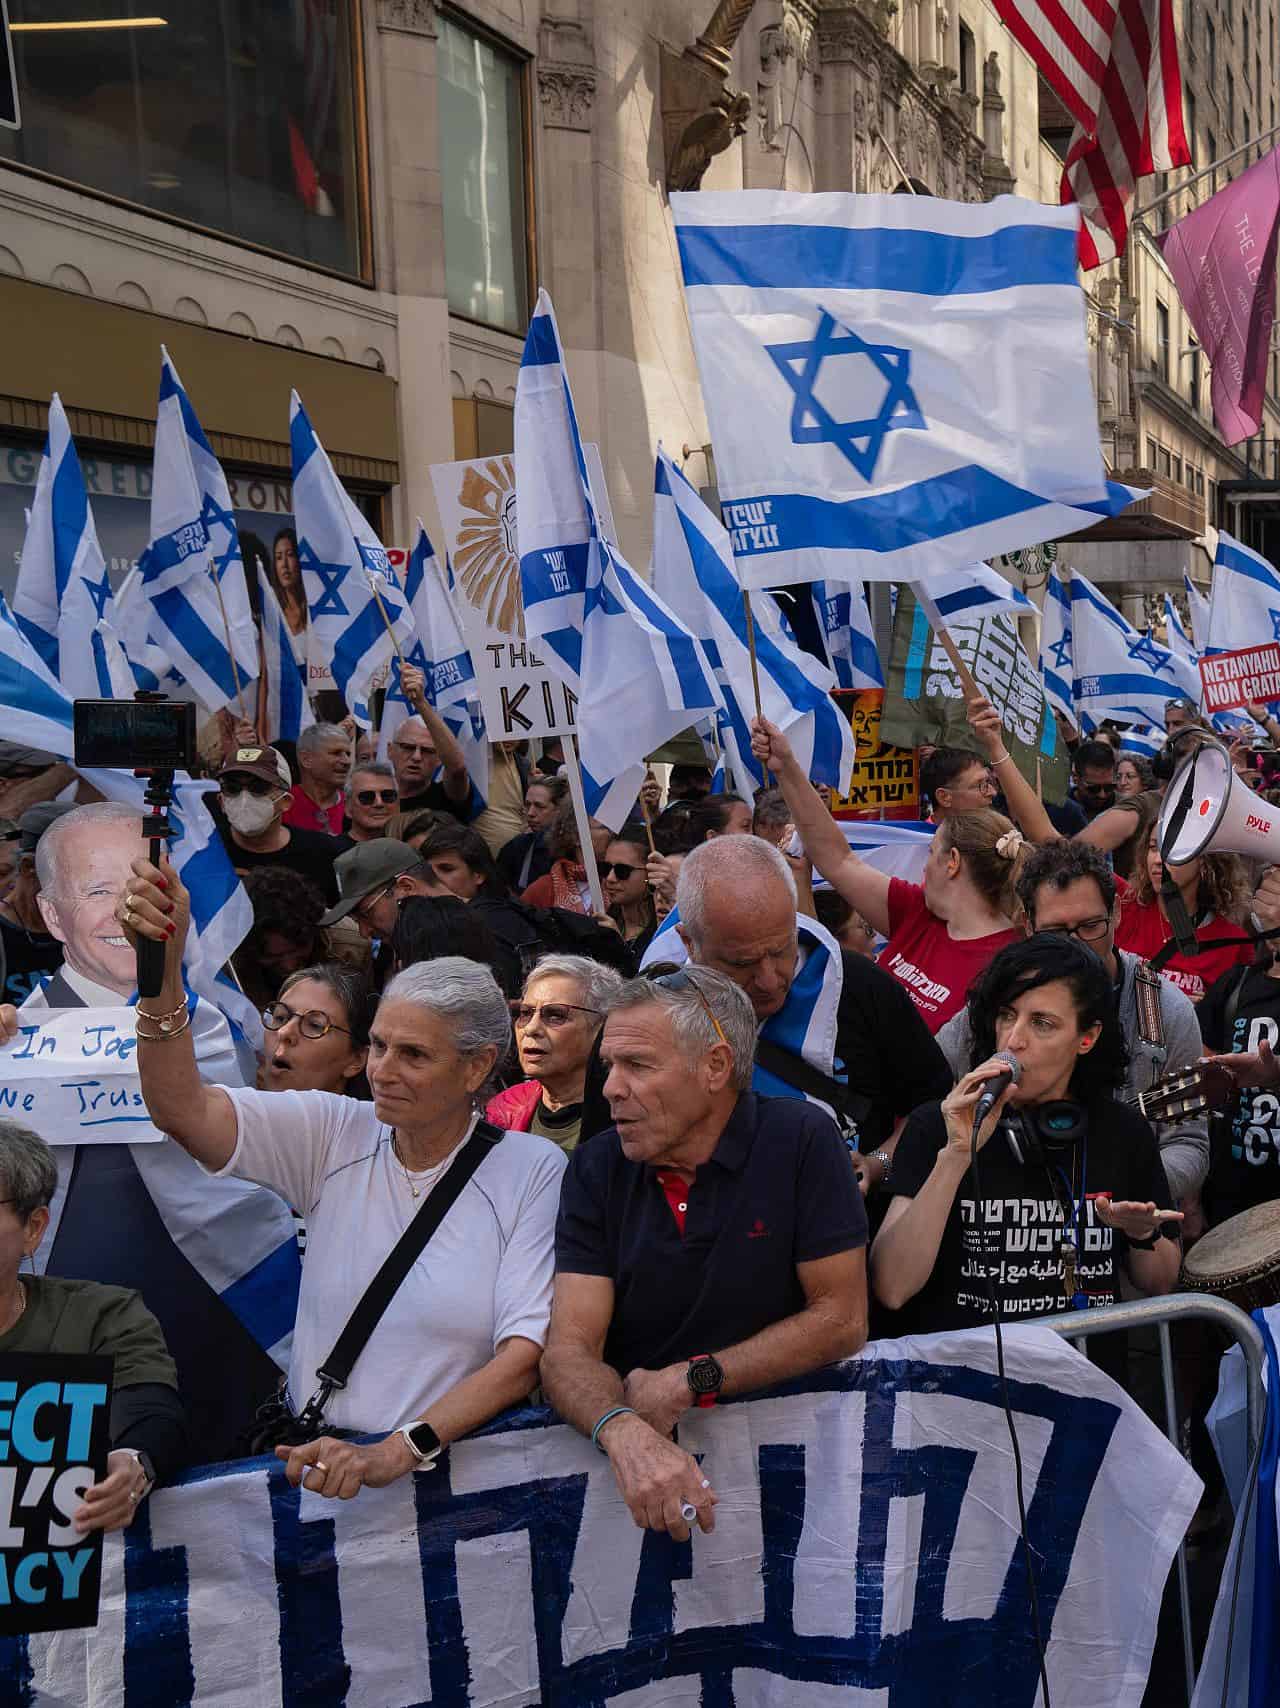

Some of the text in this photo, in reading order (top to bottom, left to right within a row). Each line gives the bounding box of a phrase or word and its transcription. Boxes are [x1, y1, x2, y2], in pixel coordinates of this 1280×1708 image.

[1202, 648, 1280, 684] NETANYAHU
[1207, 680, 1241, 706] NON
[853, 760, 913, 779] מחרי
[838, 783, 913, 805] ישרא
[12, 1025, 137, 1060] In Joe
[61, 1081, 143, 1113] Trus
